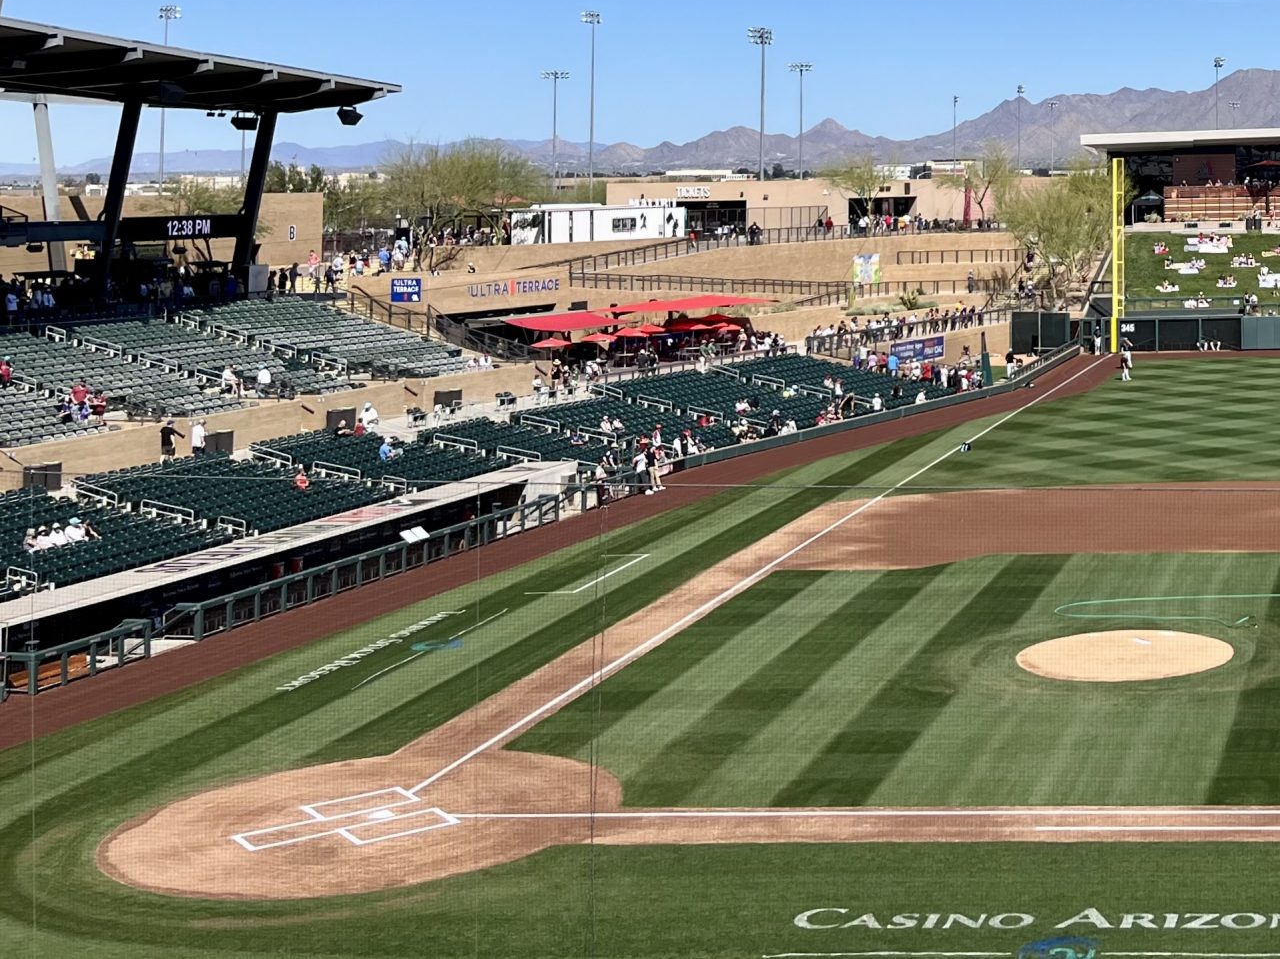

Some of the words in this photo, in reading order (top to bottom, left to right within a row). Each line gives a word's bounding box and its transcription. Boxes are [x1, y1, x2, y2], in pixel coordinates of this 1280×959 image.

[676, 186, 711, 199] TICKETS
[166, 220, 193, 236] 12:38
[195, 219, 211, 235] PM
[289, 225, 296, 240] B
[470, 284, 509, 298] ULTRA
[516, 279, 559, 294] TERRACE
[1121, 323, 1135, 333] 345
[793, 907, 1036, 930] CASINO
